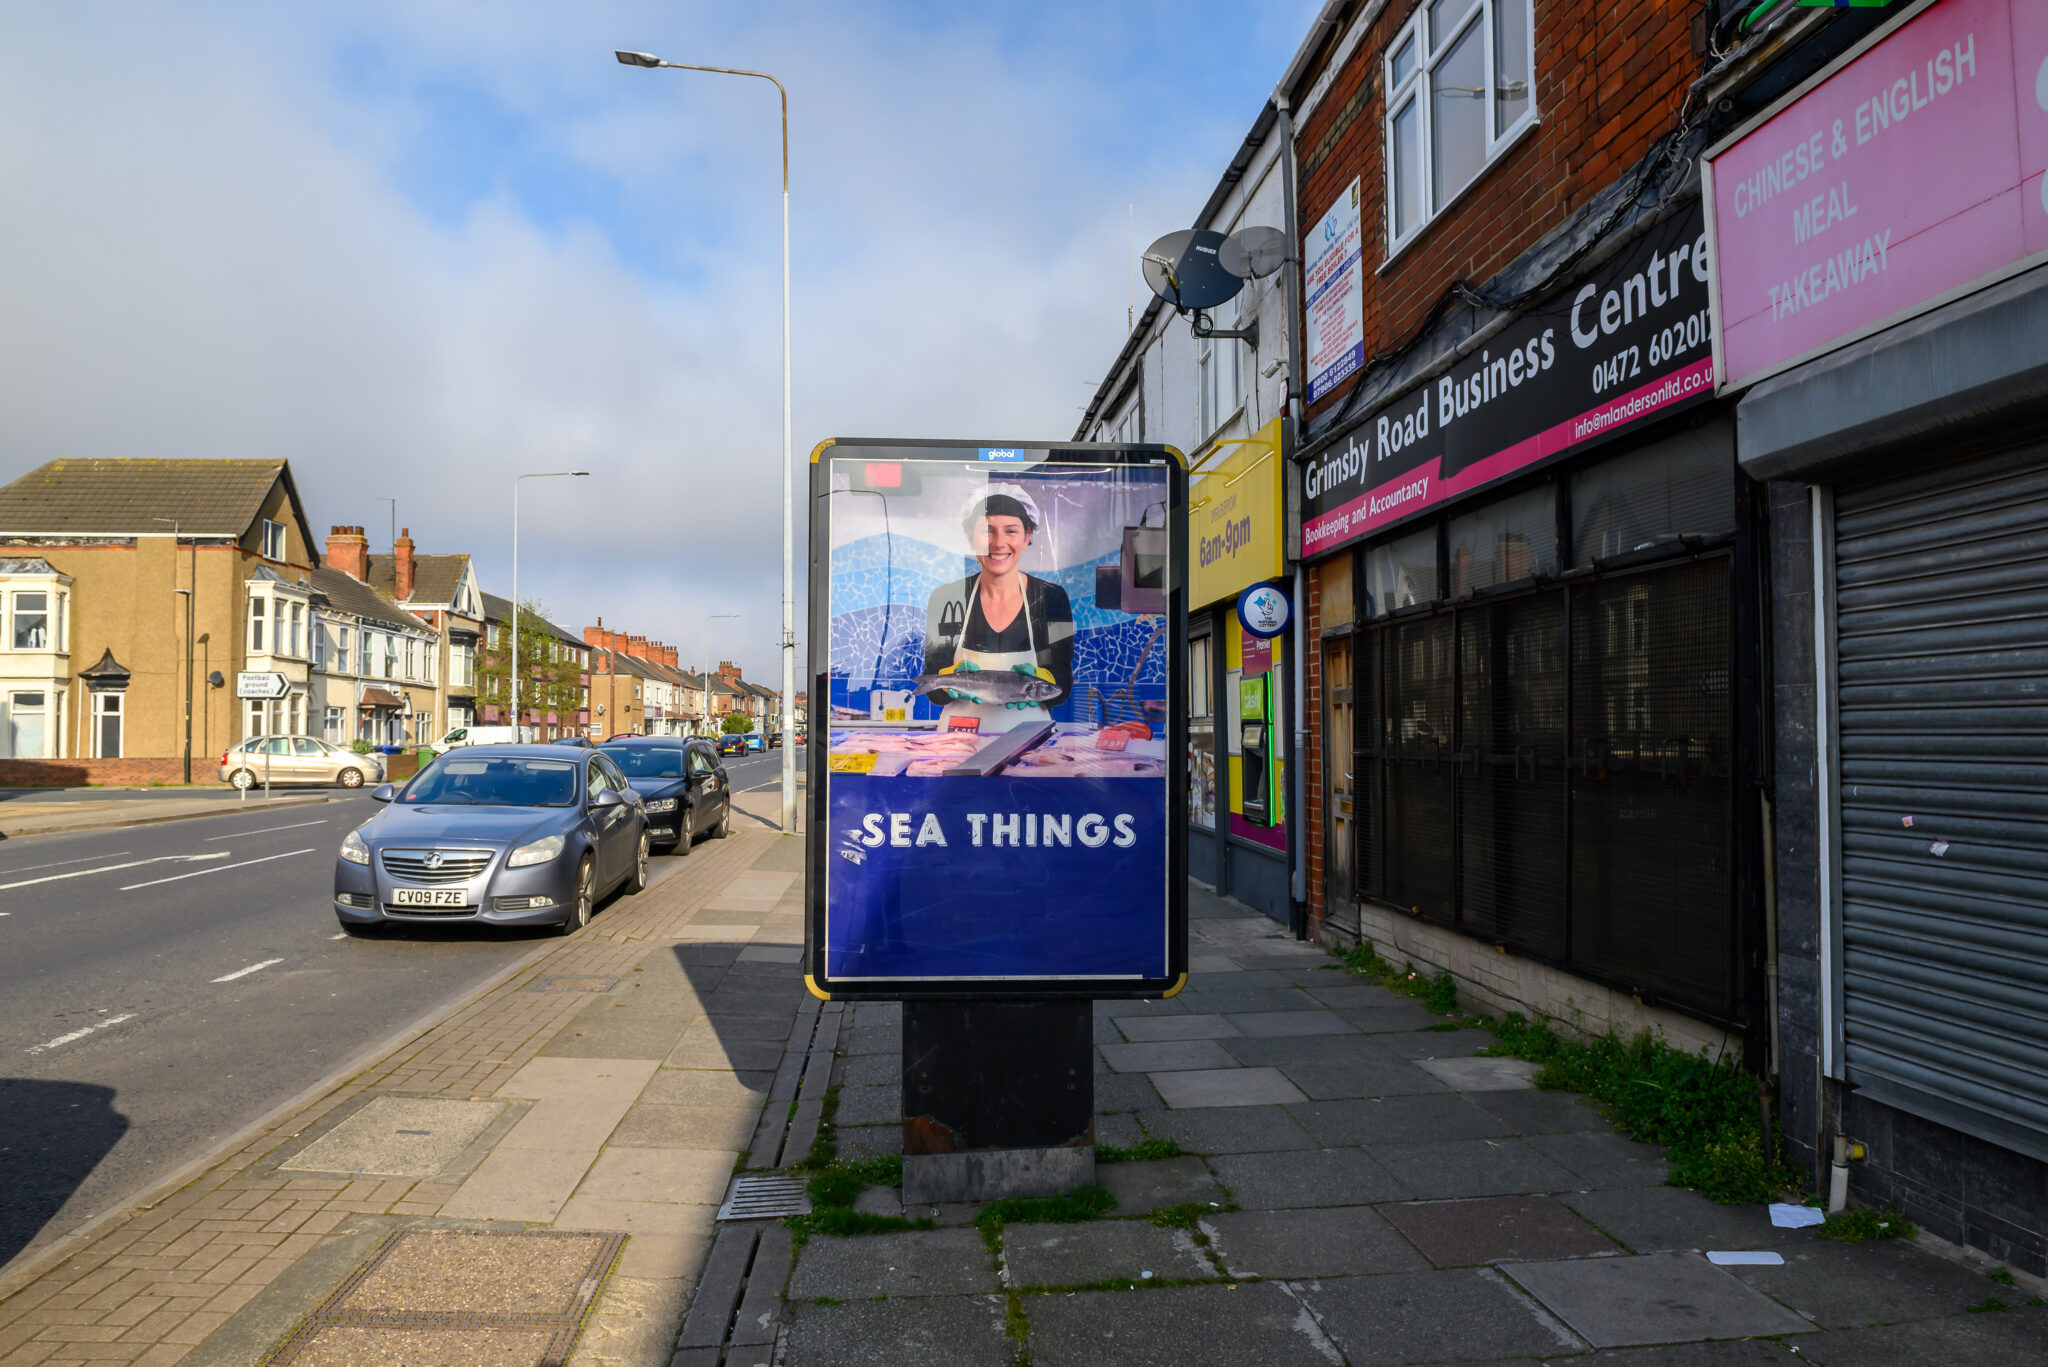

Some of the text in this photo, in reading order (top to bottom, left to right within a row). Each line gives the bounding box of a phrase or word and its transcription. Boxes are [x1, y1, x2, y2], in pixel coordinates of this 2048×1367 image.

[1734, 131, 1825, 219] CHINESE
[1831, 118, 1848, 160] &
[1855, 32, 1976, 147] ENGLISH
[1793, 181, 1858, 246] MEAL
[1767, 228, 1892, 323] TAKEAWAY
[1305, 437, 1370, 500] Grimsby
[1377, 388, 1429, 462] Road
[1439, 328, 1555, 429] Business
[1570, 232, 1709, 349] Centre
[1313, 372, 1329, 389] 0800
[1592, 345, 1641, 394] 01472
[1575, 367, 1713, 439] info@mlandersonltd.co.u
[988, 449, 1015, 460] global
[1305, 476, 1429, 545] Bookkeeping and Accountancy
[1200, 515, 1251, 568] 6am-9pm
[861, 813, 1137, 848] SEA THINGS
[398, 891, 462, 904] CV09 FZE
